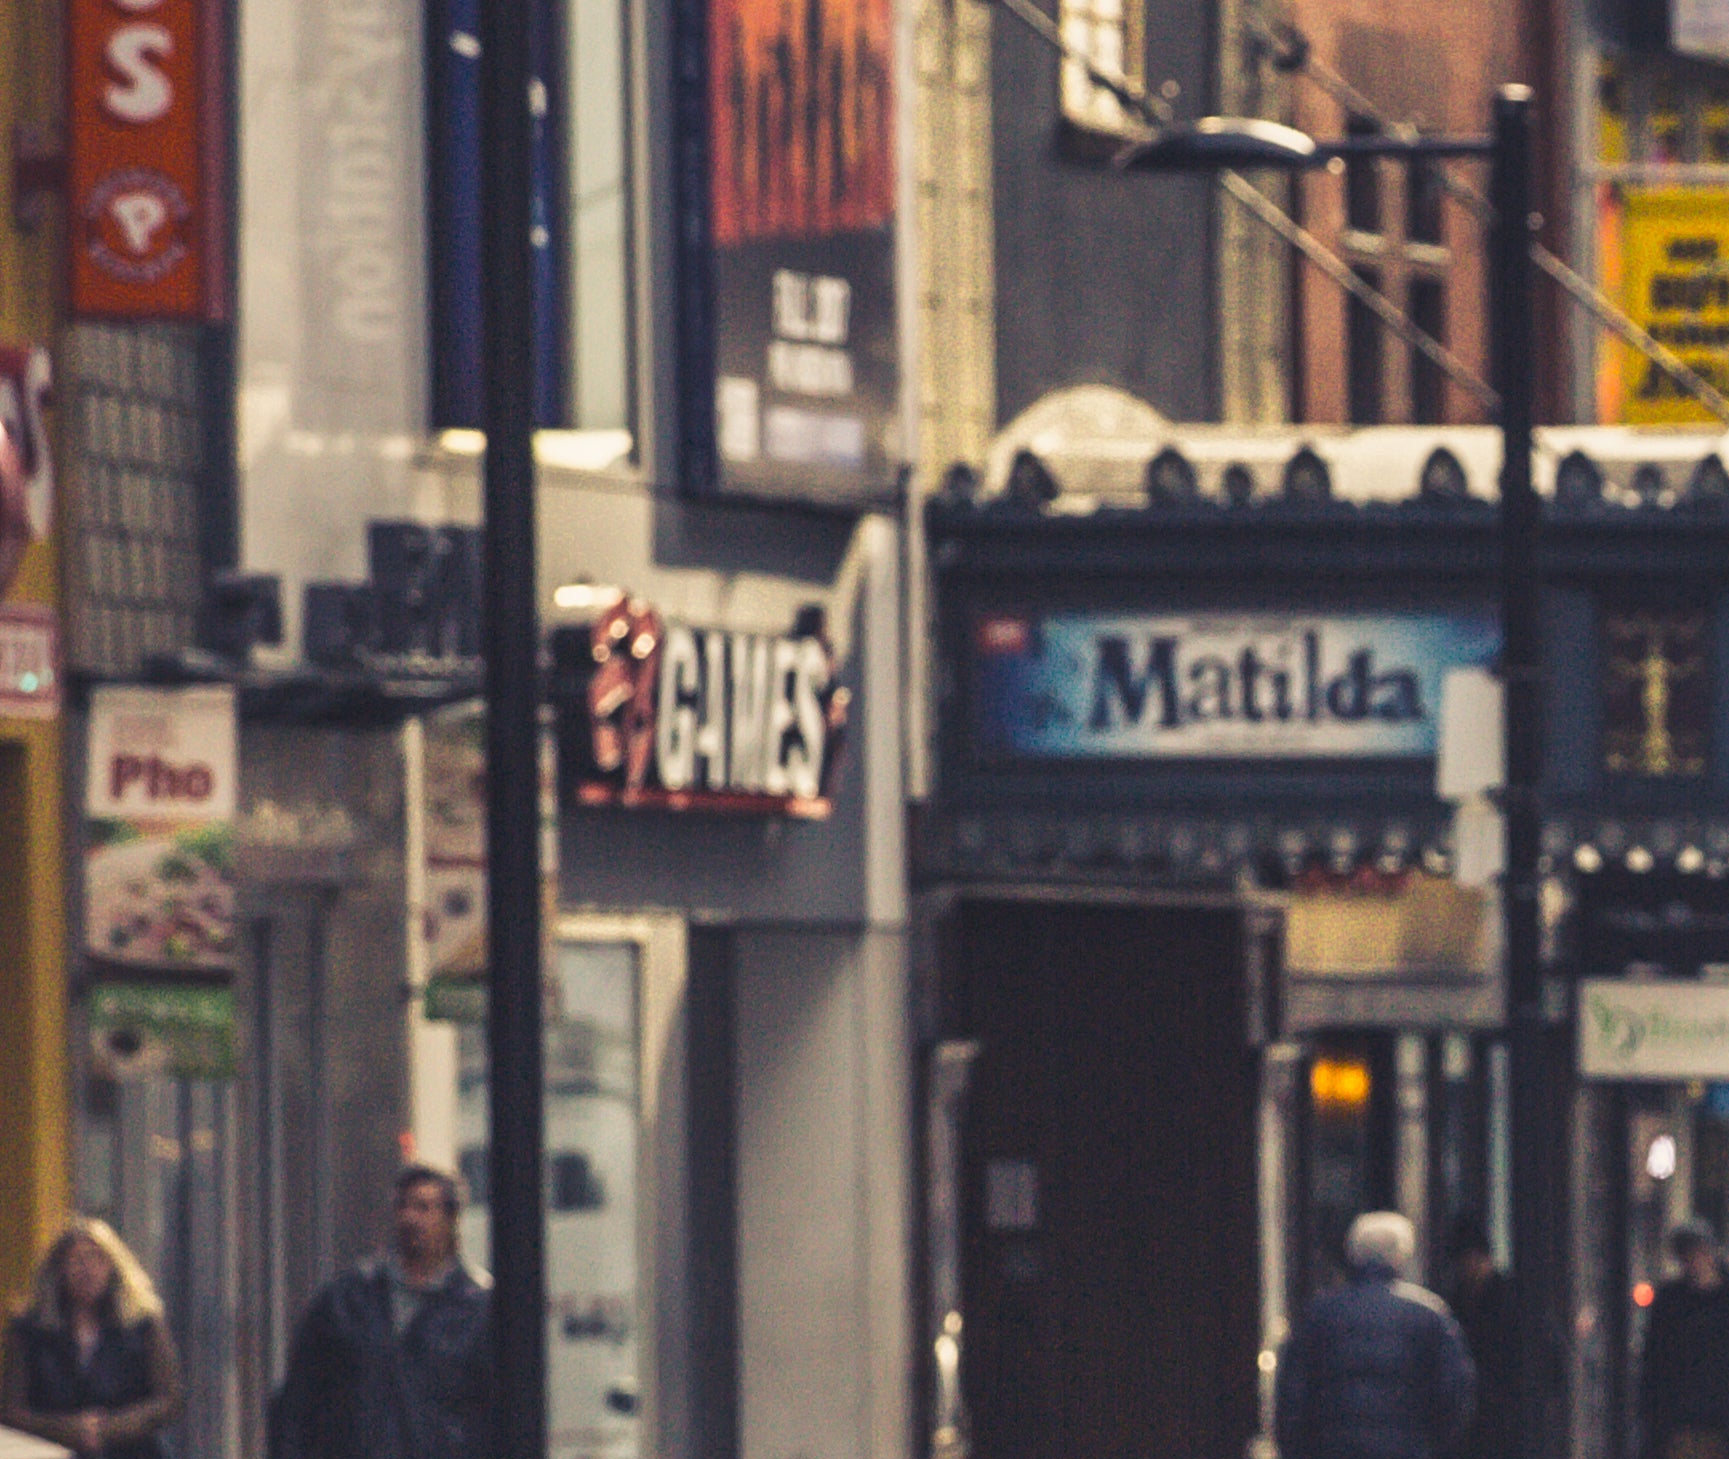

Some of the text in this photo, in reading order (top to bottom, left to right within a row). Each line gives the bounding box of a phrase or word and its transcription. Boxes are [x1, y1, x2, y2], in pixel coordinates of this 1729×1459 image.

[104, 0, 174, 121] S
[657, 624, 828, 798] GAMES
[1089, 627, 1425, 730] Matilda
[111, 754, 213, 803] Pho
